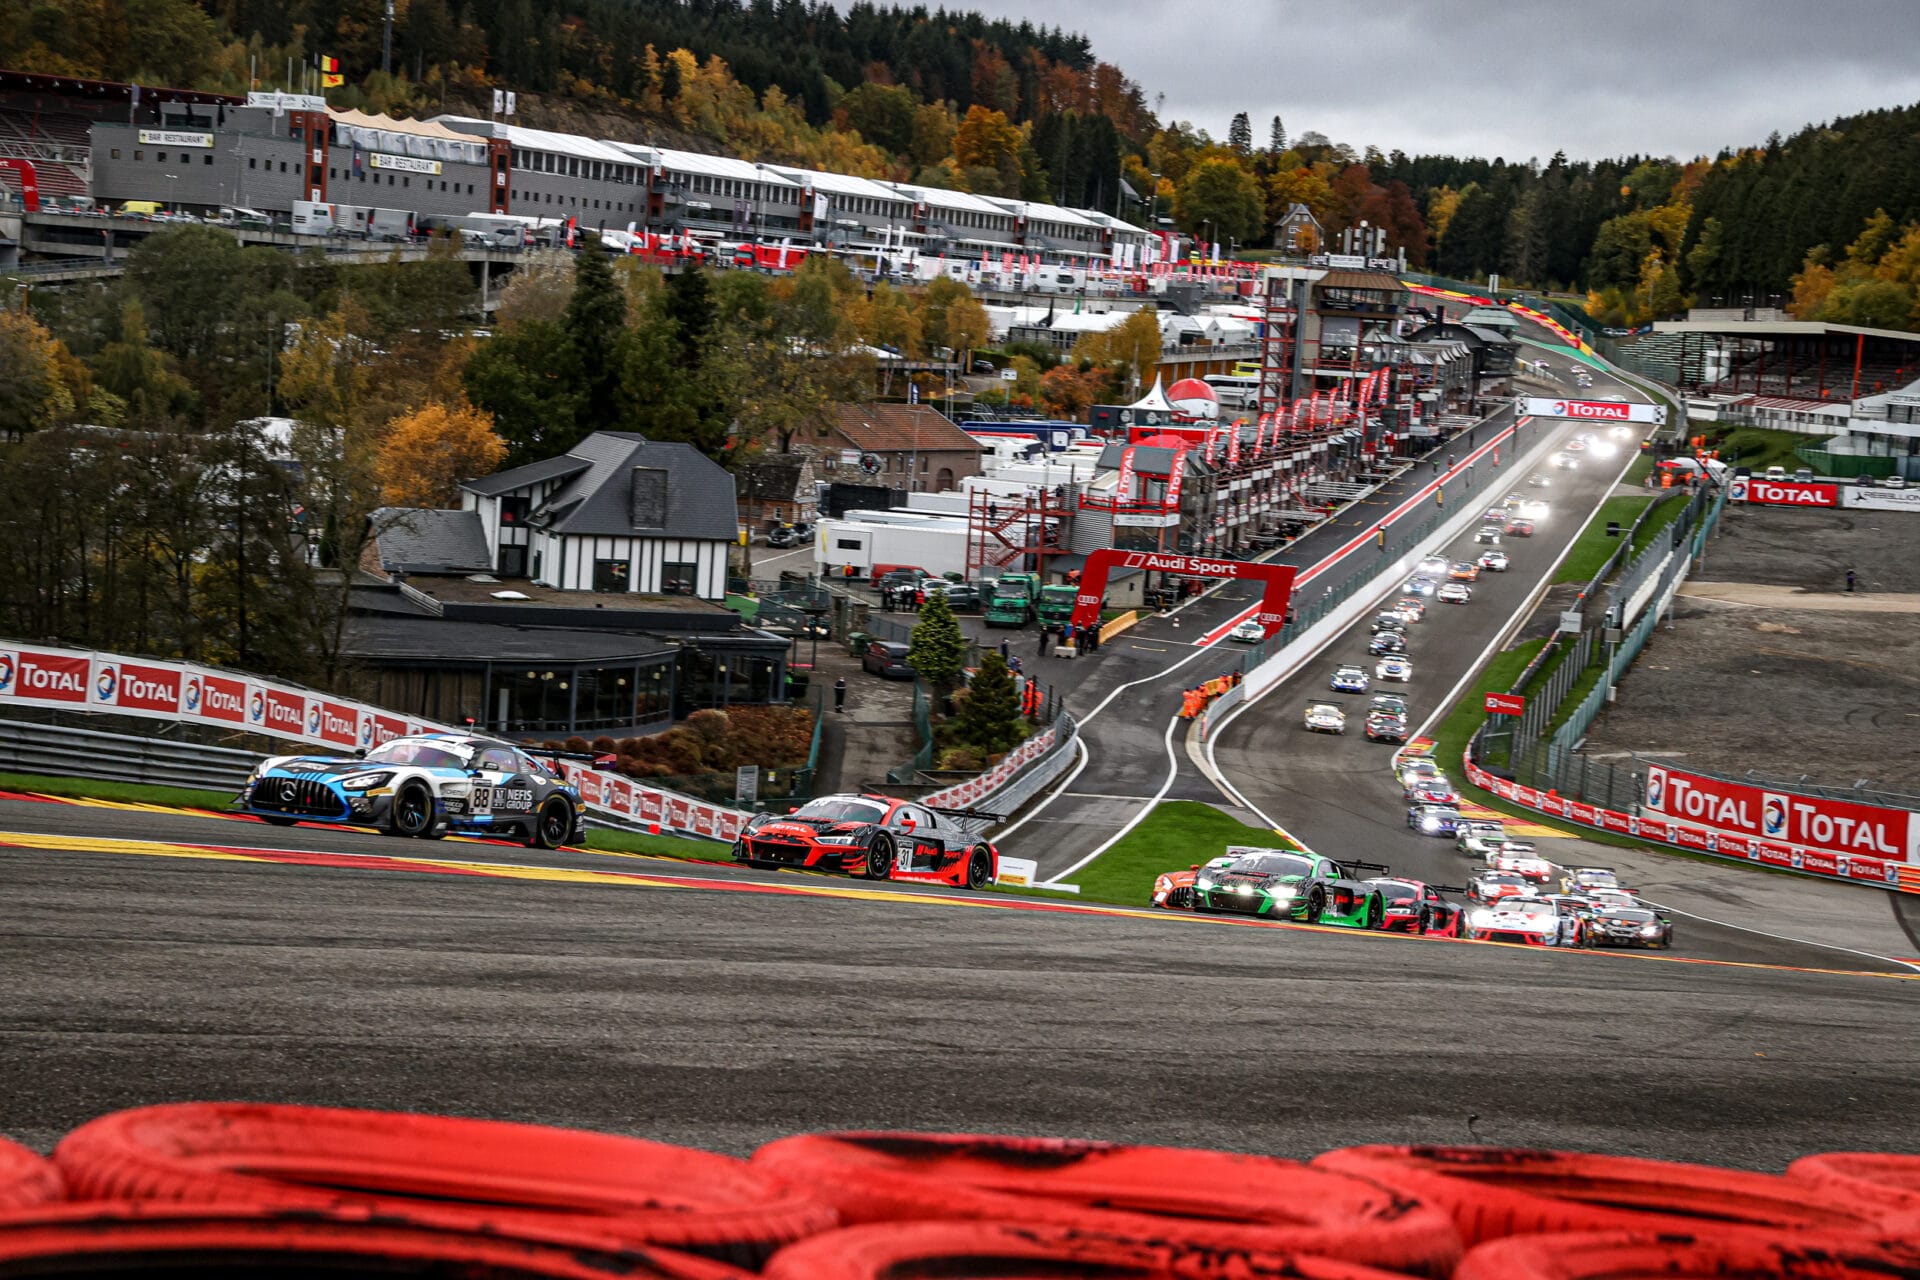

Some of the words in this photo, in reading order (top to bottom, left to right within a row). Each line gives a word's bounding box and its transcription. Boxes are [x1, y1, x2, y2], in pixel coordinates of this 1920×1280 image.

[148, 133, 162, 141] BAR
[164, 134, 205, 145] RESTAURANT
[378, 155, 392, 166] BAR
[394, 158, 435, 173] RESTAURANT
[1569, 402, 1628, 418] TOTAL
[1120, 450, 1135, 490] TOTAL
[1170, 453, 1187, 491] TOTAL
[1752, 483, 1831, 503] TOTAL
[1146, 556, 1185, 569] Audi
[1189, 560, 1238, 575] Sport
[20, 662, 85, 692] TOTAL
[122, 674, 178, 703] TOTAL
[204, 686, 244, 713] TOTAL
[1498, 700, 1521, 709] TOTAL
[267, 698, 303, 726] TOTAL
[323, 712, 357, 737] TOTAL
[474, 788, 489, 808] 88
[507, 789, 533, 801] NEFIS
[1669, 778, 1756, 829] TOTAL
[506, 800, 533, 810] GROUP
[769, 824, 807, 833] TOTAL
[1639, 821, 1666, 837] TOTAL
[1677, 829, 1706, 845] TOTAL
[1793, 802, 1899, 854] TOTAL
[1718, 837, 1747, 854] TOTAL
[1759, 847, 1790, 862] TOTAL
[900, 848, 909, 866] 31
[1804, 854, 1836, 870] TOTAL
[1850, 861, 1884, 877] TOTAL
